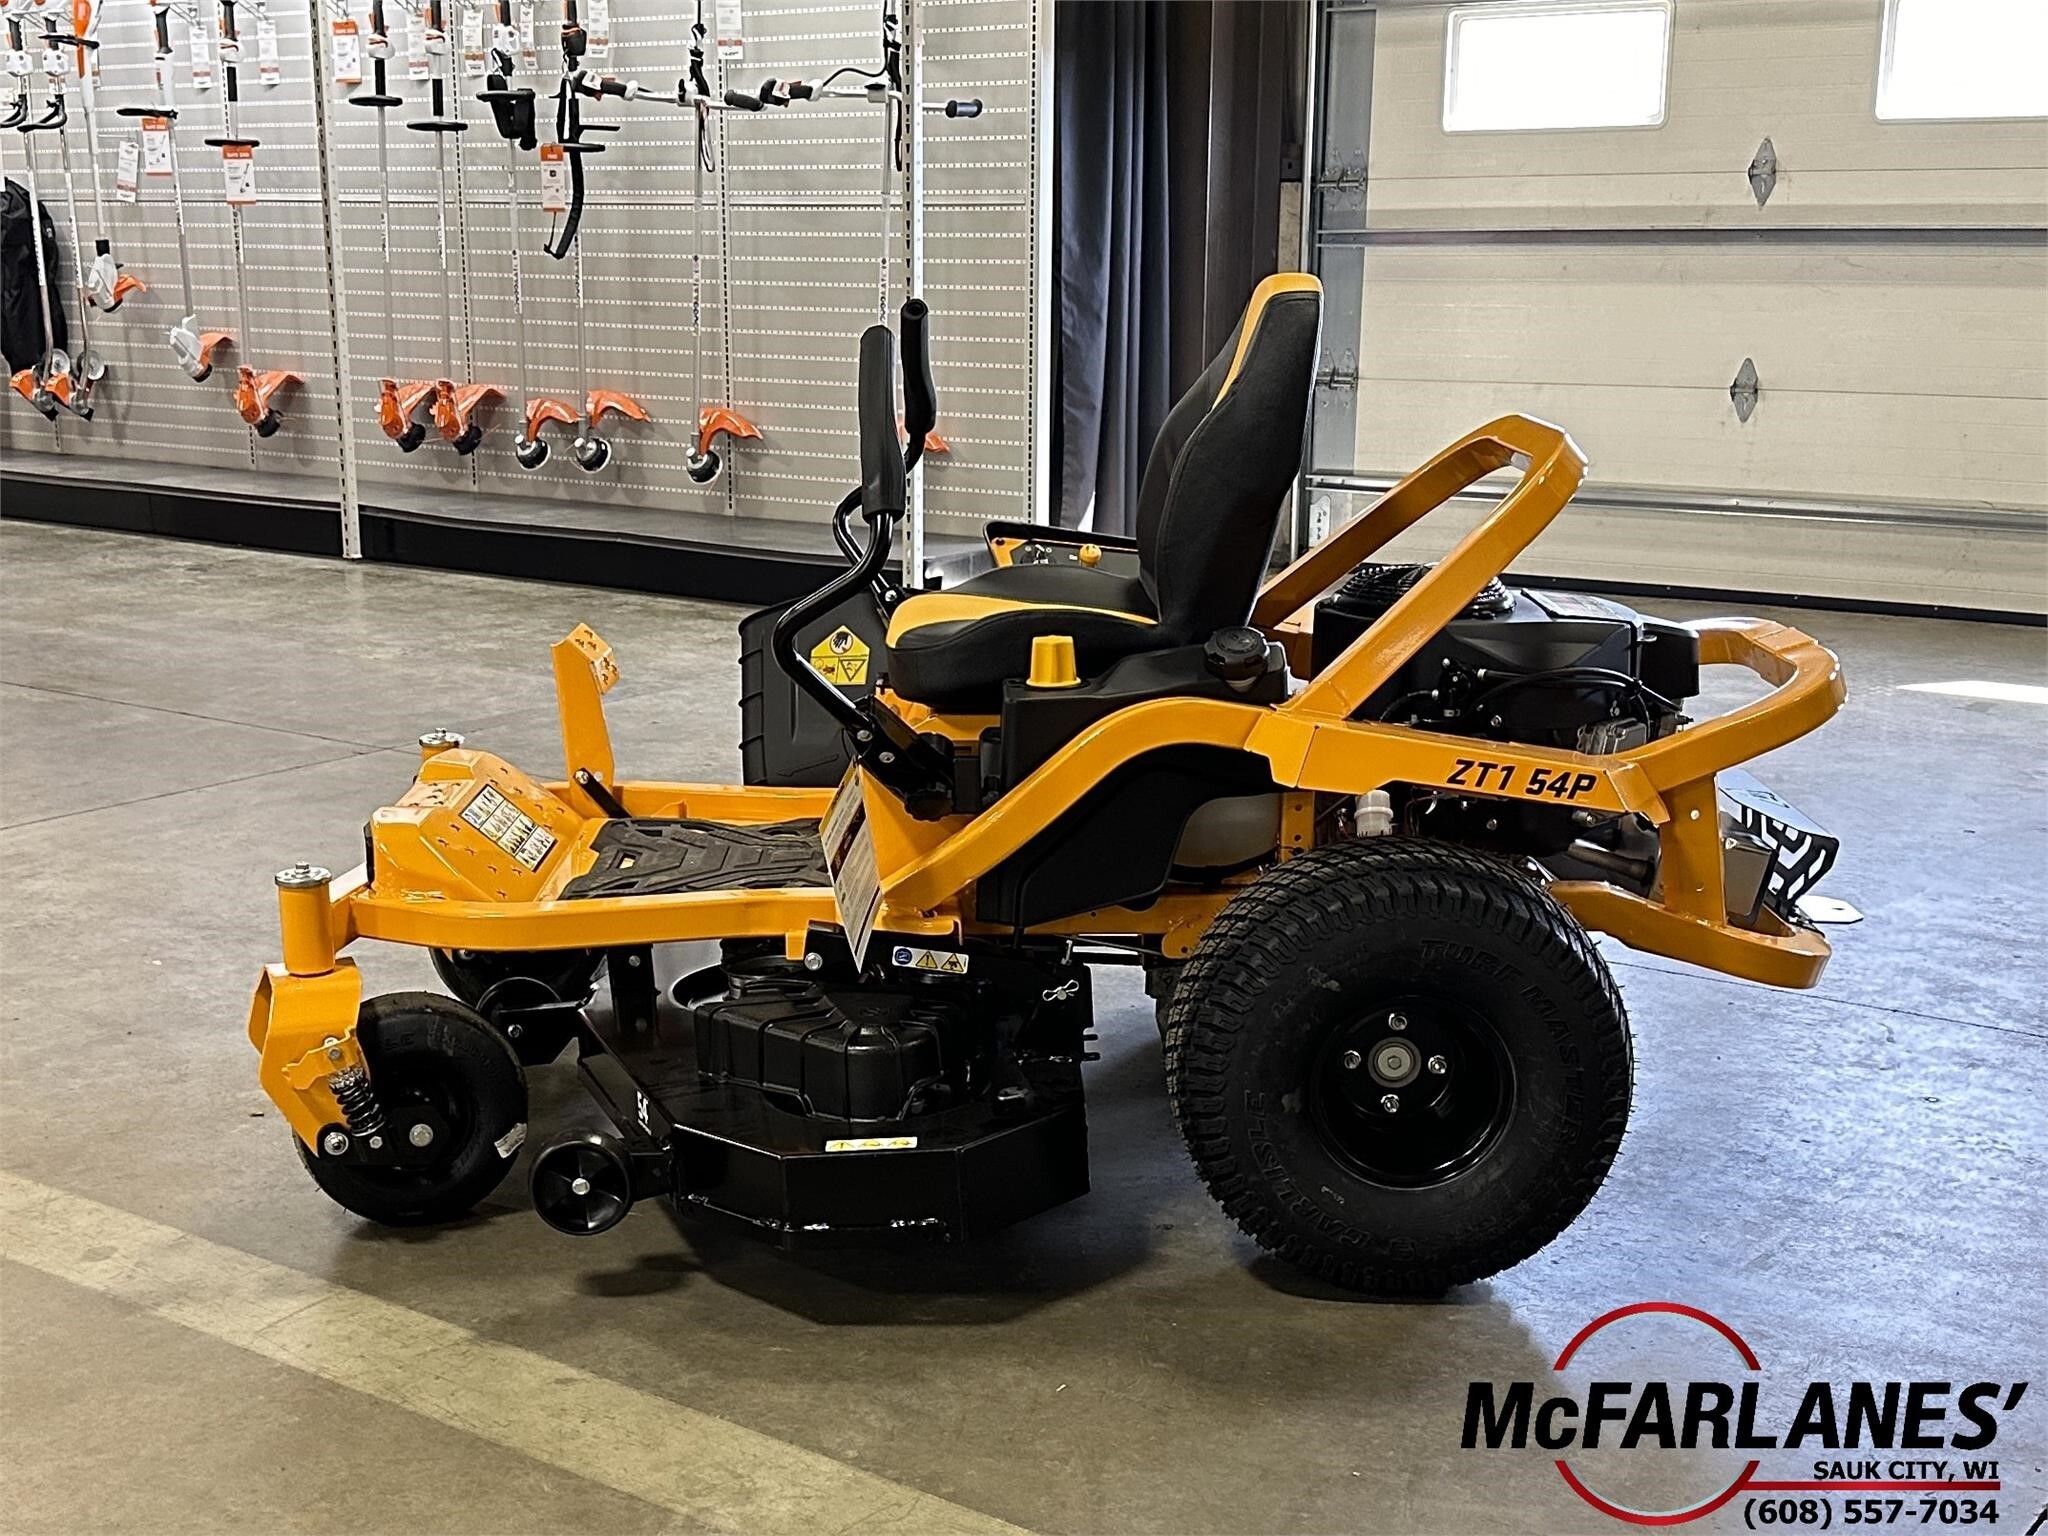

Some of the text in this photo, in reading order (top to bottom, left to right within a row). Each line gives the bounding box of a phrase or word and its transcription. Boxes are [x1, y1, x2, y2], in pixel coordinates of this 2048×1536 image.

[1447, 758, 1598, 800] ZT1 54P
[1420, 938, 1585, 1148] TURF MASTER
[1245, 1090, 1370, 1247] CARLISLE
